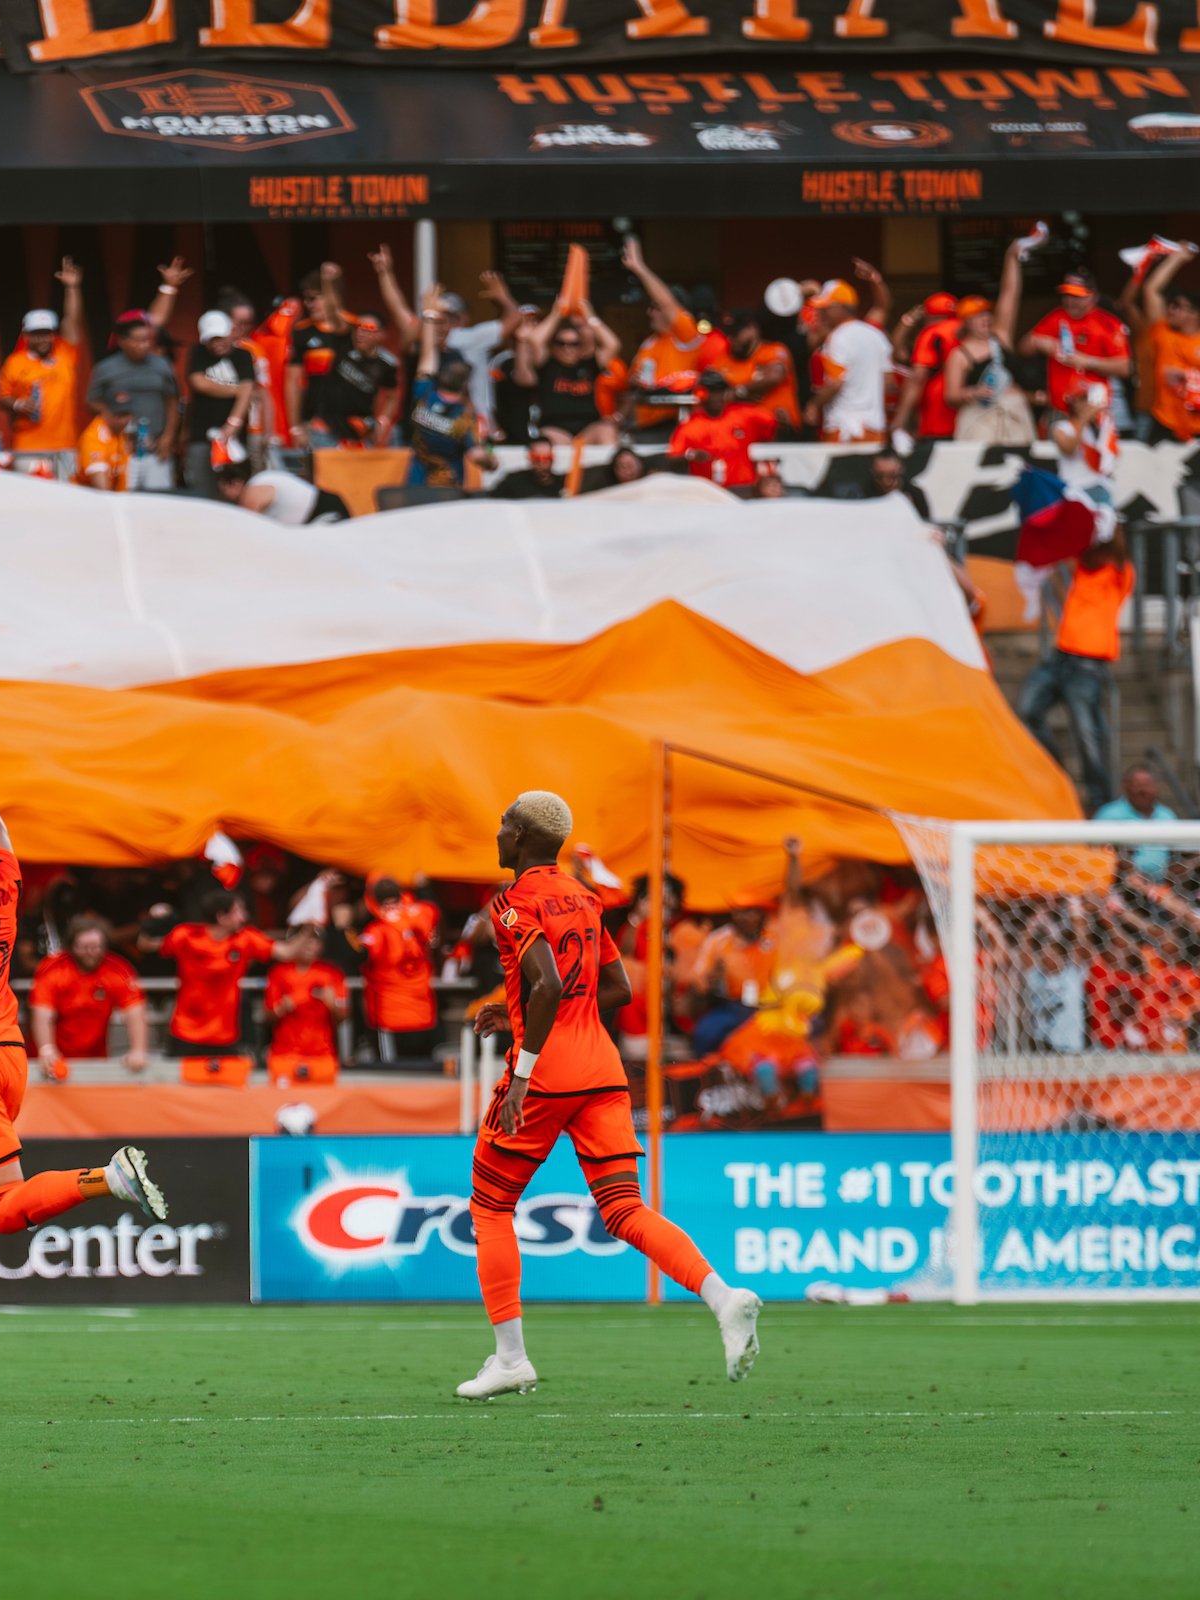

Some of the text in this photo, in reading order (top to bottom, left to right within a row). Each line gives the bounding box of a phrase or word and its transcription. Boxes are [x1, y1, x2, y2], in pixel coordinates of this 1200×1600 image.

[495, 68, 1191, 105] HUSTLE TOWN
[249, 173, 430, 207] HUSTLE TOWN
[802, 168, 983, 202] HUSTLE TOWN
[724, 1161, 827, 1208] THE
[837, 1161, 892, 1208] #1
[734, 1226, 919, 1274] BRAND
[993, 1224, 1200, 1273] AMERIC
